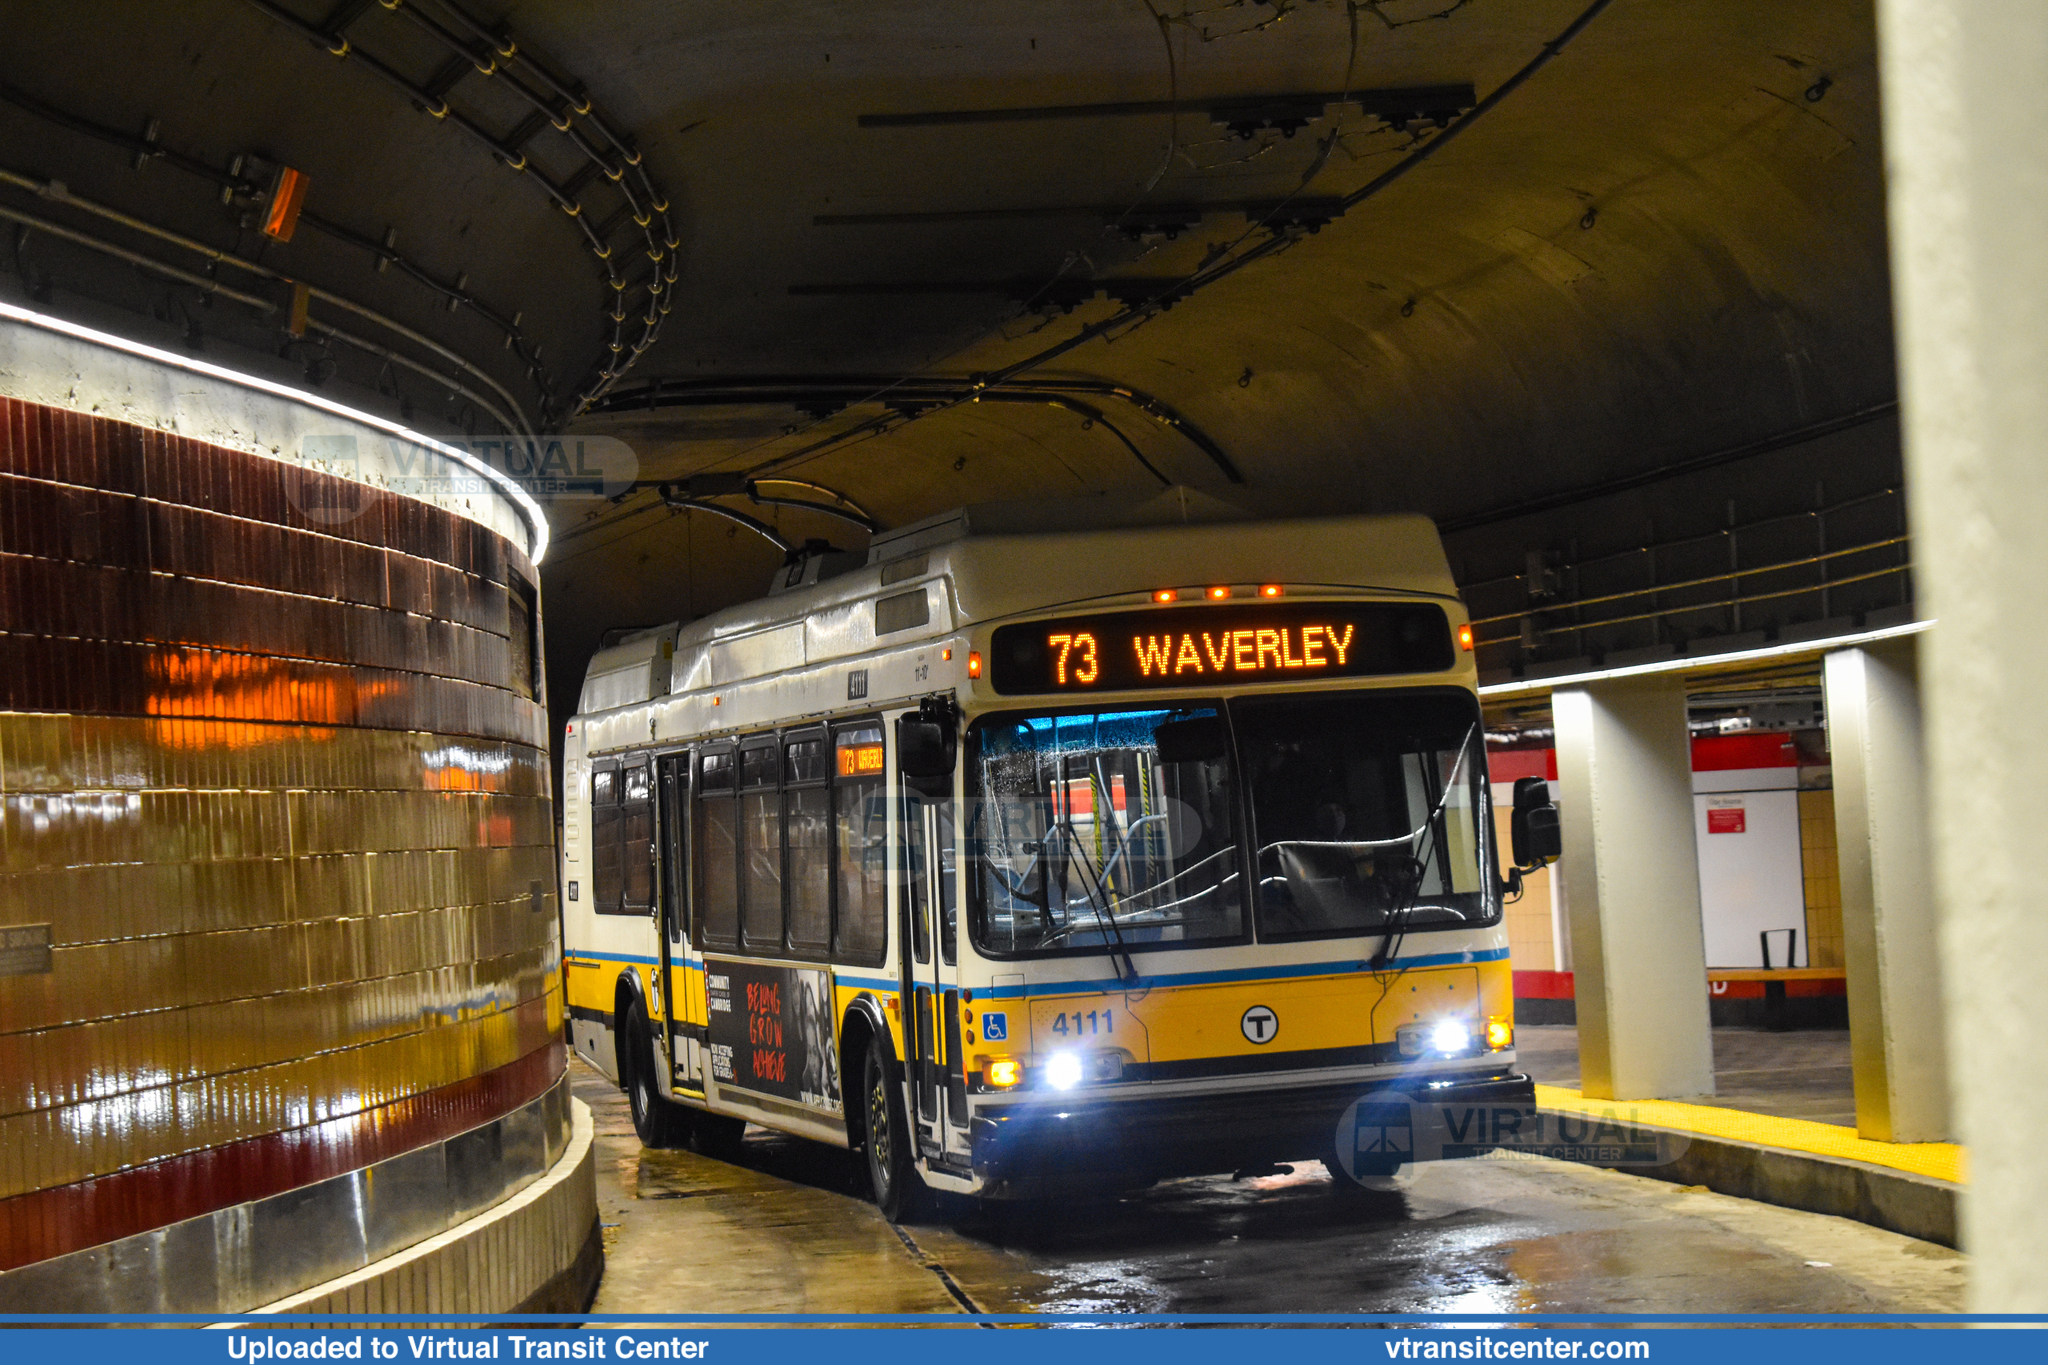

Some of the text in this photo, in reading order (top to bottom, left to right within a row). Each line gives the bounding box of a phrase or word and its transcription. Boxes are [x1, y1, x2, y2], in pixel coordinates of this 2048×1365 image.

[1049, 624, 1354, 684] 73 WAVERLEY
[850, 671, 867, 697] 4111
[845, 749, 855, 774] 73
[746, 982, 781, 1016] BELONG
[750, 1012, 783, 1048] GROW
[1052, 1008, 1114, 1037] 4111
[1247, 1014, 1272, 1038] T
[753, 1048, 786, 1083] ACHIEVE
